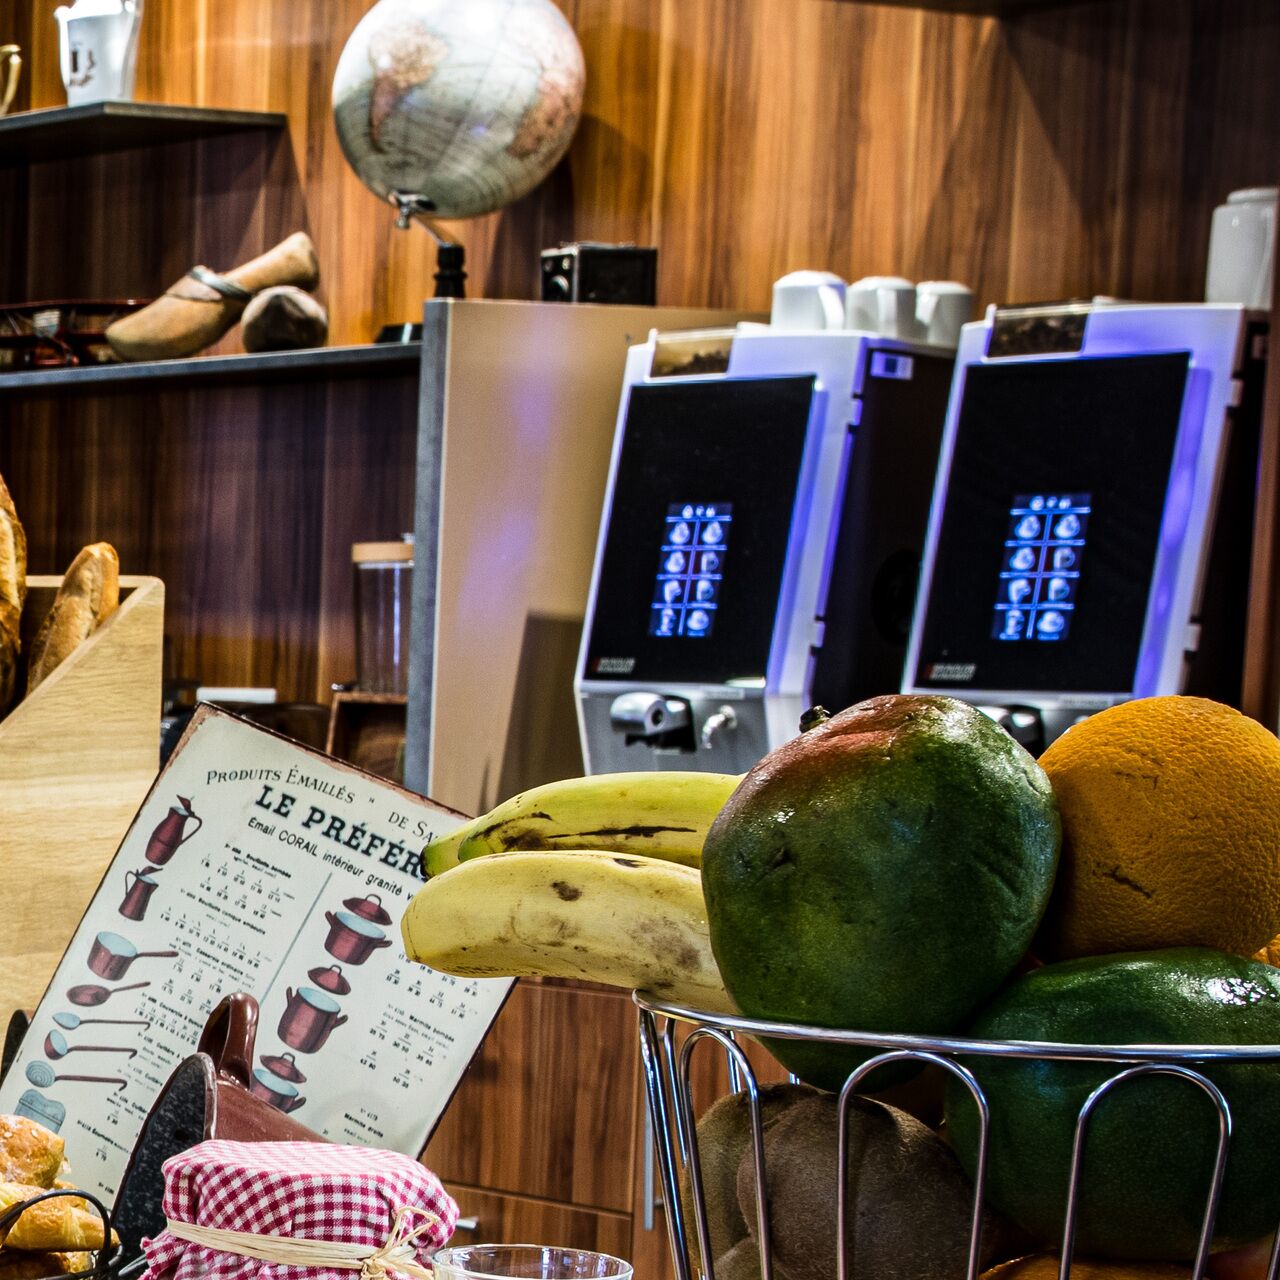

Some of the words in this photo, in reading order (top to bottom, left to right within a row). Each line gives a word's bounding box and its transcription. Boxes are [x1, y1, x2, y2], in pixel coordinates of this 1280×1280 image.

[206, 768, 282, 785] PRODUITS
[286, 764, 356, 804] ÉMAILLÉS
[388, 811, 409, 829] DE
[413, 820, 439, 844] SA
[255, 784, 296, 818] LE
[301, 806, 431, 884] PRÉFÉR
[248, 816, 277, 838] Émail
[278, 830, 318, 857] CORAIL
[322, 849, 364, 878] intérieur
[365, 872, 403, 897] granité
